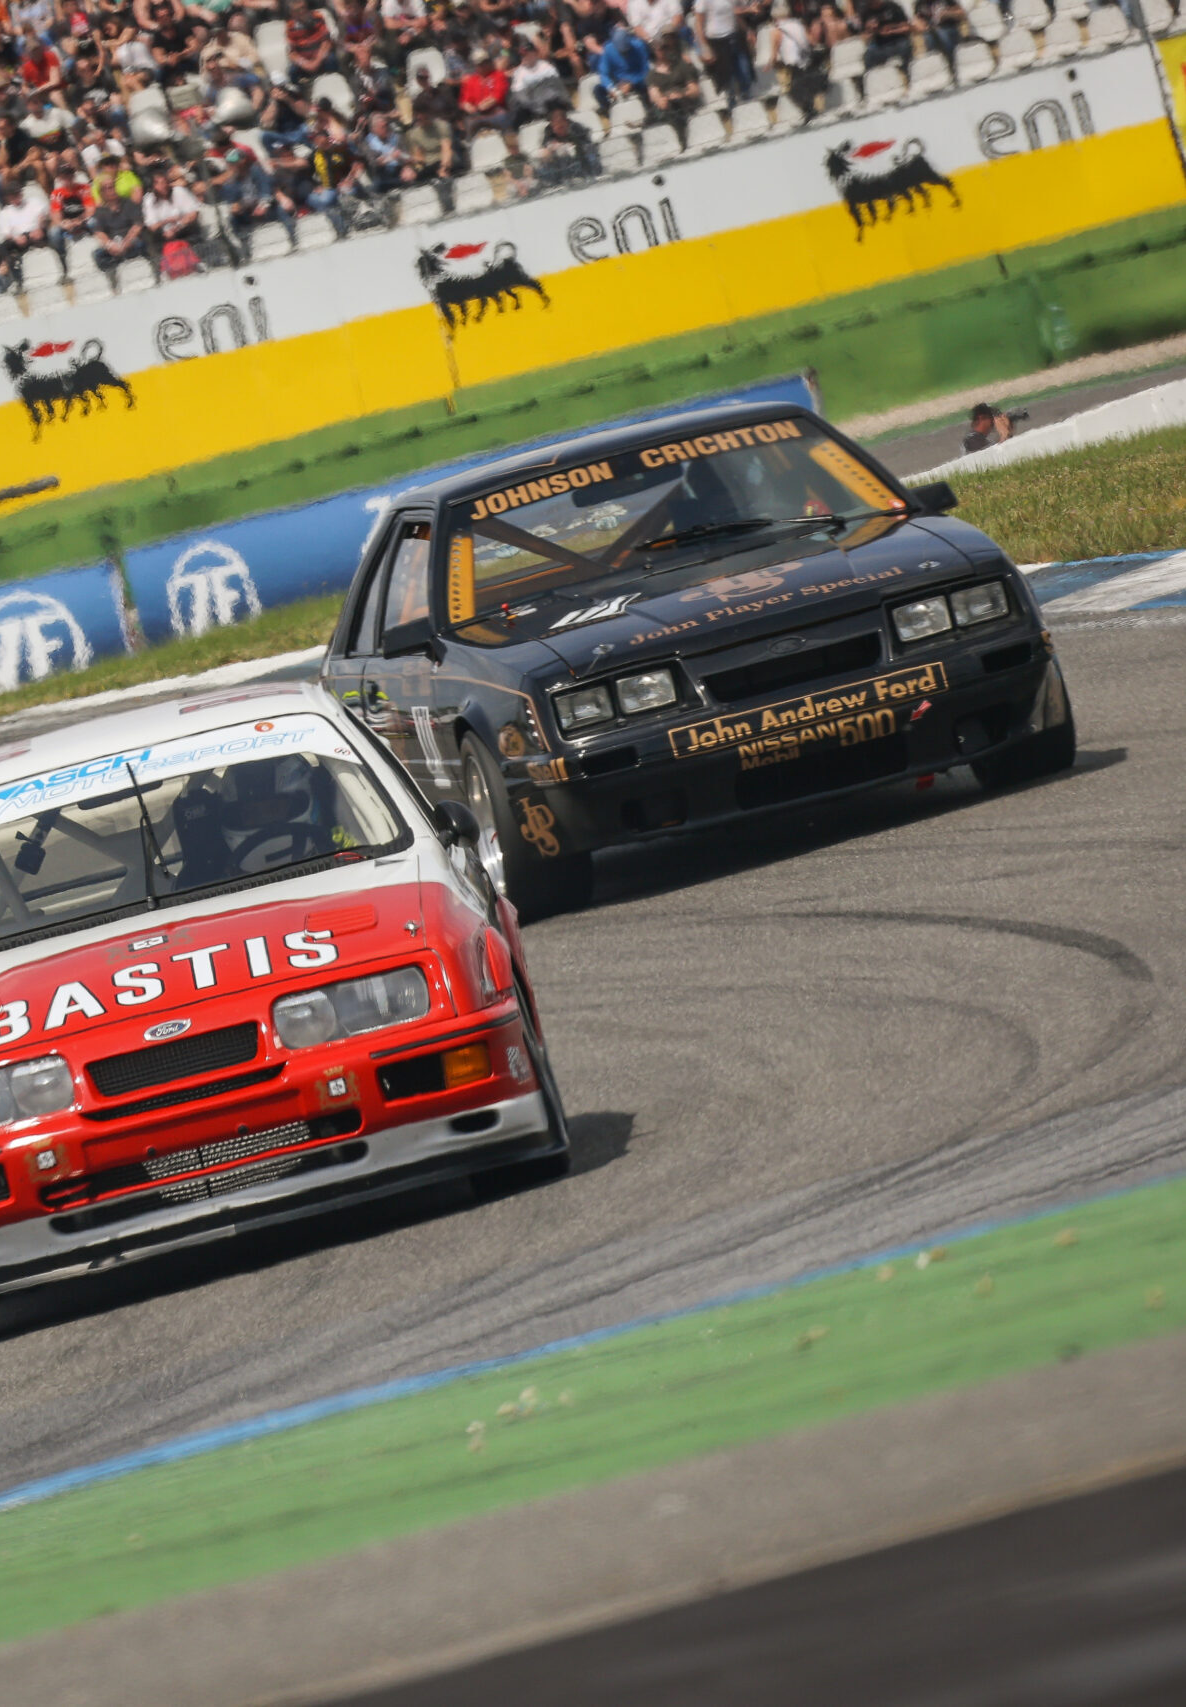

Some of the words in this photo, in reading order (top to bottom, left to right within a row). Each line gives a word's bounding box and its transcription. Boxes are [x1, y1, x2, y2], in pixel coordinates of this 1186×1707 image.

[979, 69, 1095, 160] eni
[567, 175, 682, 264] eni
[155, 274, 272, 363] eni
[470, 461, 614, 521] JOHNSON
[639, 420, 804, 469] CRICHTON
[629, 619, 700, 646] John
[703, 591, 794, 622] Player
[799, 566, 905, 598] Special
[687, 719, 752, 751] John
[760, 691, 868, 731] Andrew
[874, 666, 938, 701] Ford
[738, 722, 836, 759] NISSAN
[837, 708, 896, 747] 500
[154, 1022, 181, 1038] Ford
